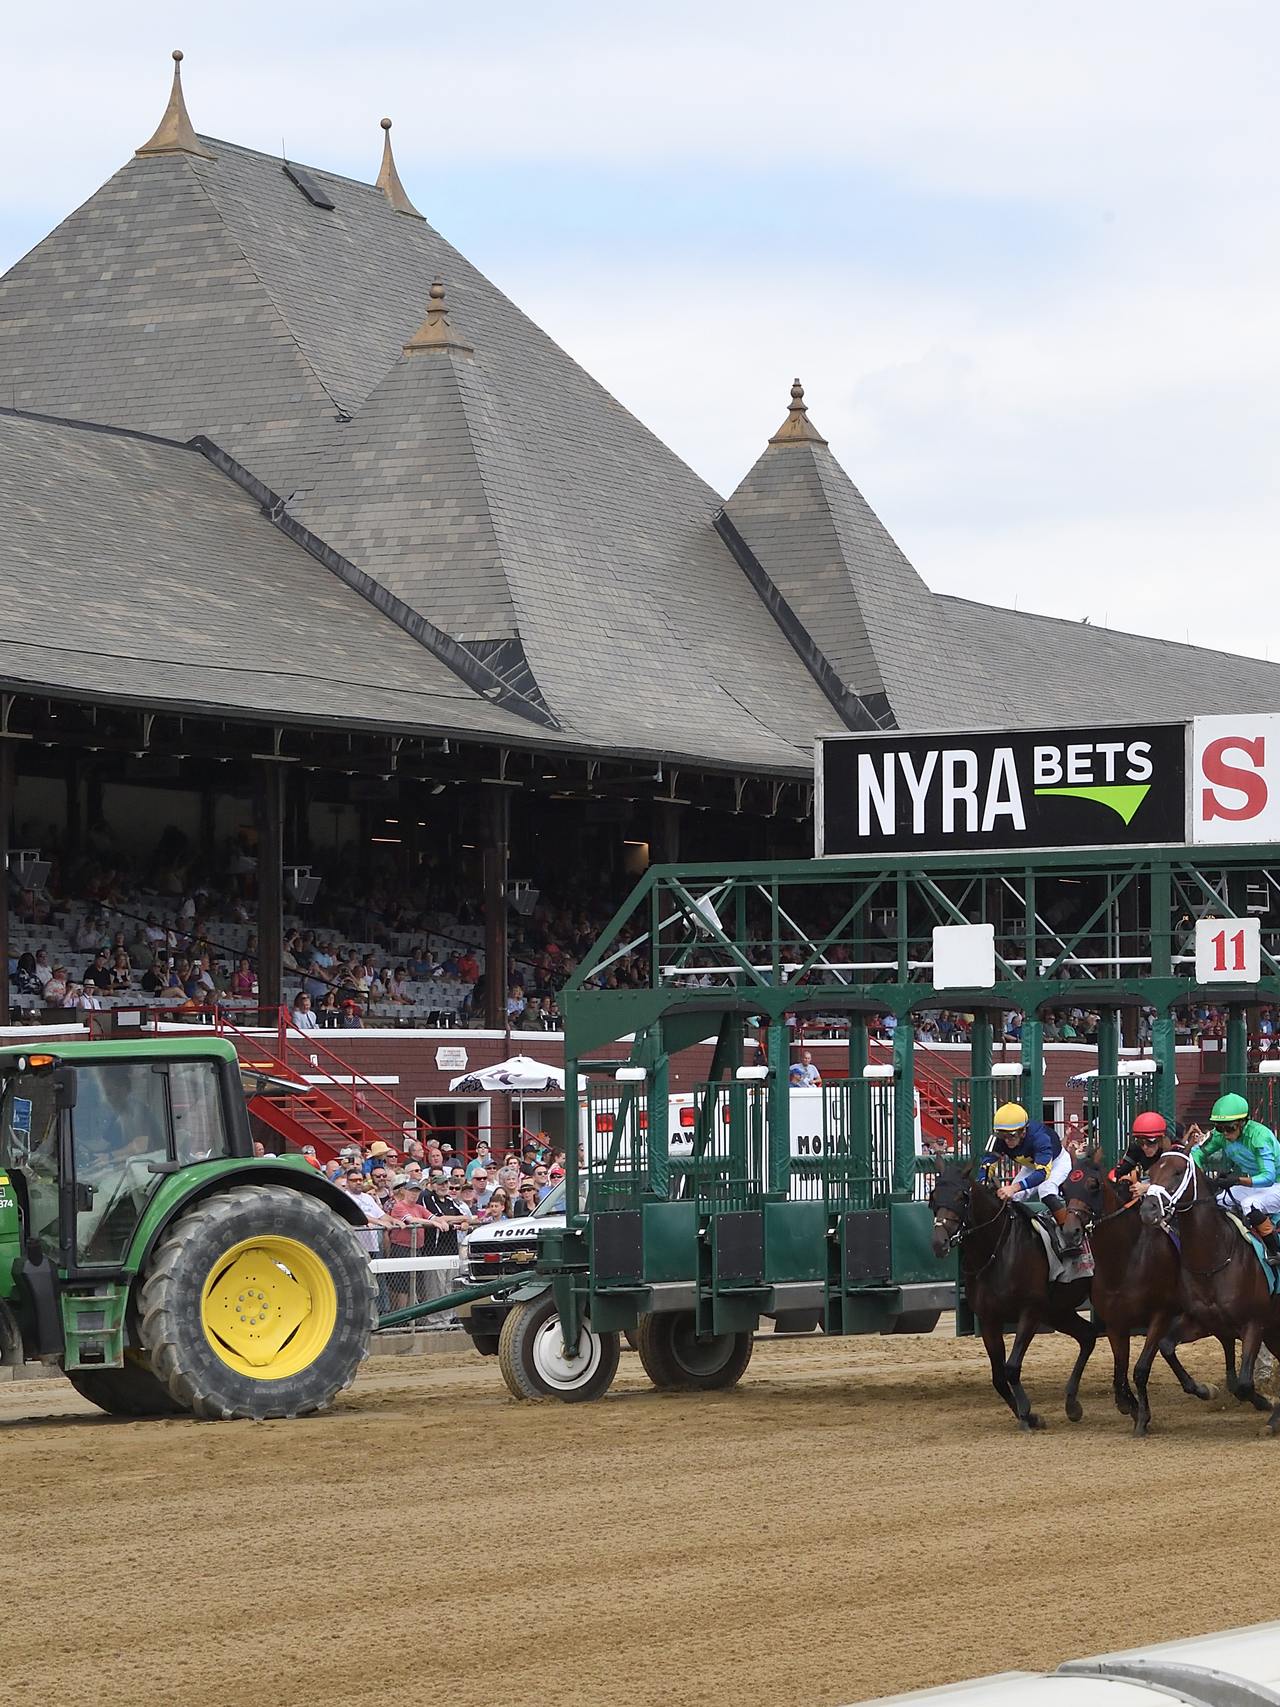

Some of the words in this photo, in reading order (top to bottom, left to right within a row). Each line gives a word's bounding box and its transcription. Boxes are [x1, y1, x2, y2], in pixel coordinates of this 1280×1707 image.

[858, 748, 1027, 836] NYRA
[1034, 742, 1153, 784] BETS
[1211, 929, 1246, 972] 11
[494, 1228, 541, 1238] MOHA
